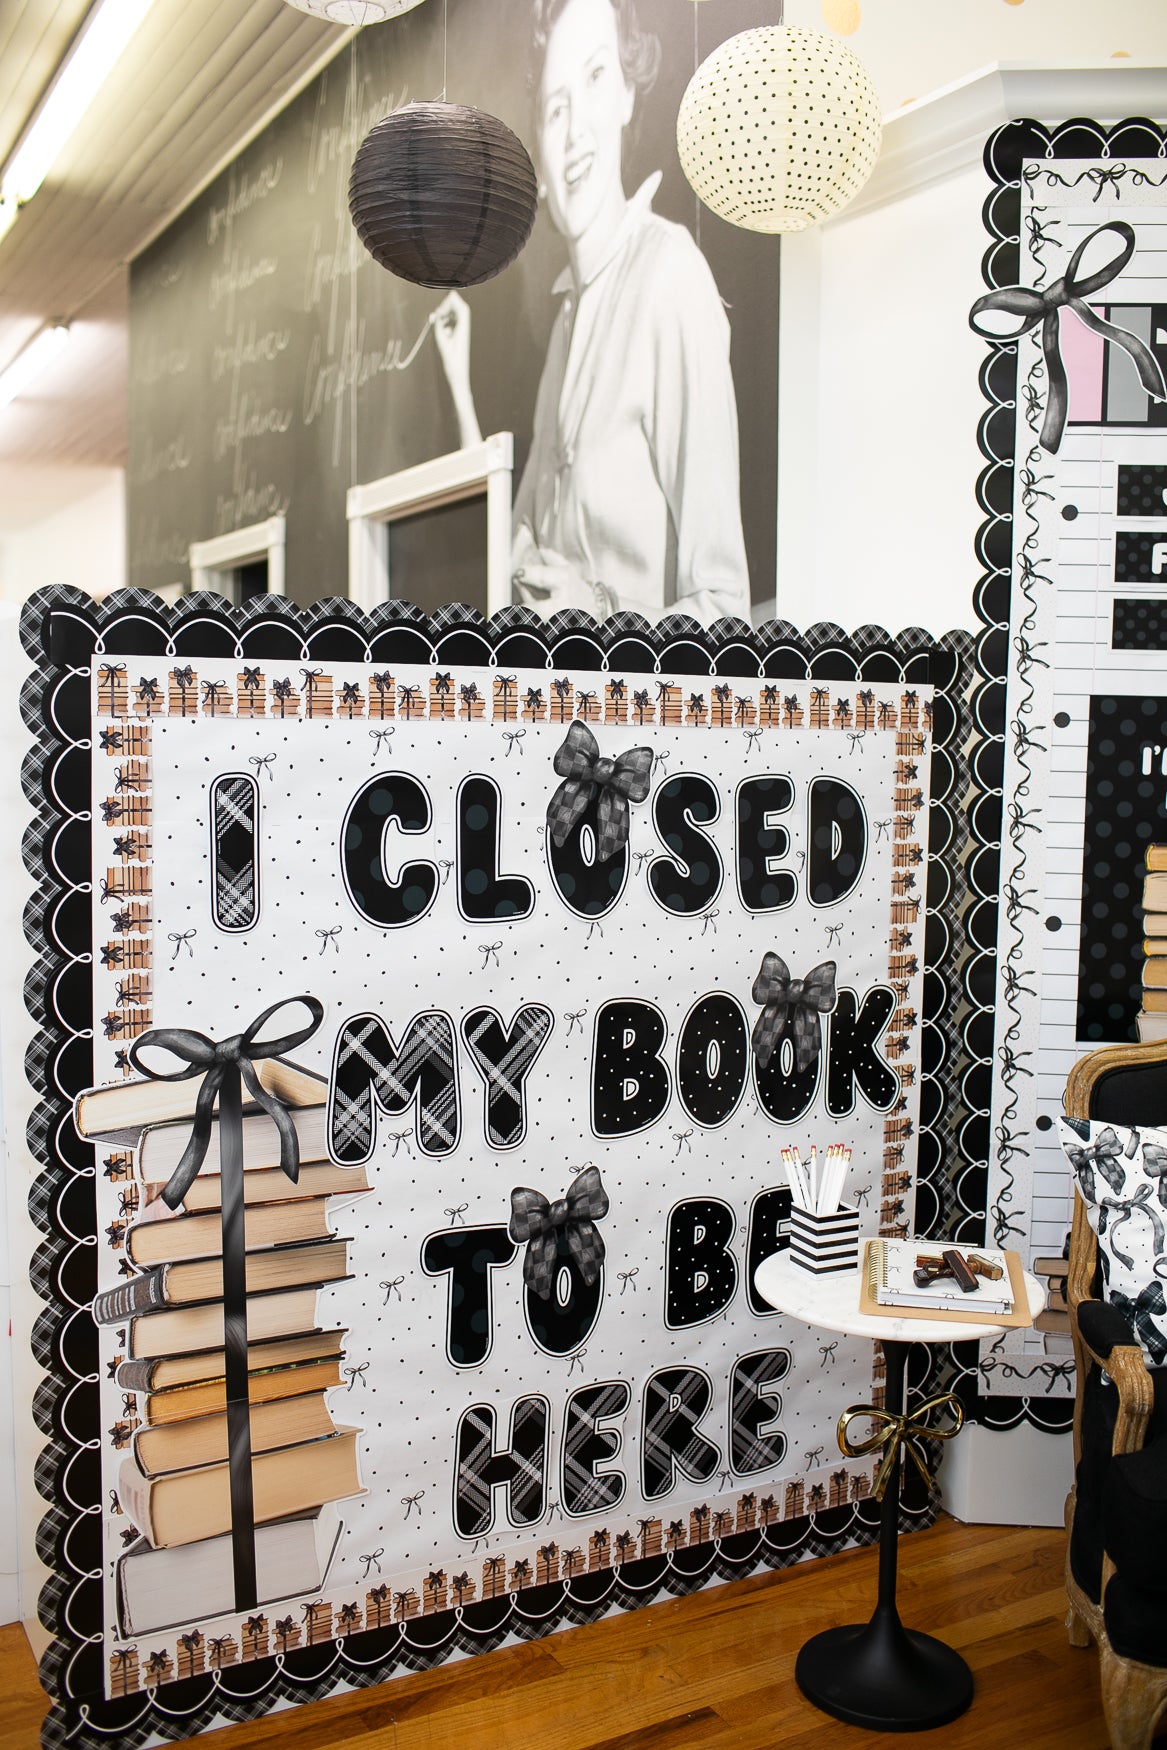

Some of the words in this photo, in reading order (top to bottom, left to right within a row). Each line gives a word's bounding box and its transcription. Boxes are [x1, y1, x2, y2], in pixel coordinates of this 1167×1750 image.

[1142, 745, 1167, 775] I'
[211, 772, 260, 931] I
[340, 770, 868, 929] CLOSED
[328, 1003, 555, 1166] MY
[591, 985, 901, 1140] BOOK
[421, 1219, 606, 1369] TO
[452, 1347, 792, 1540] HERE
